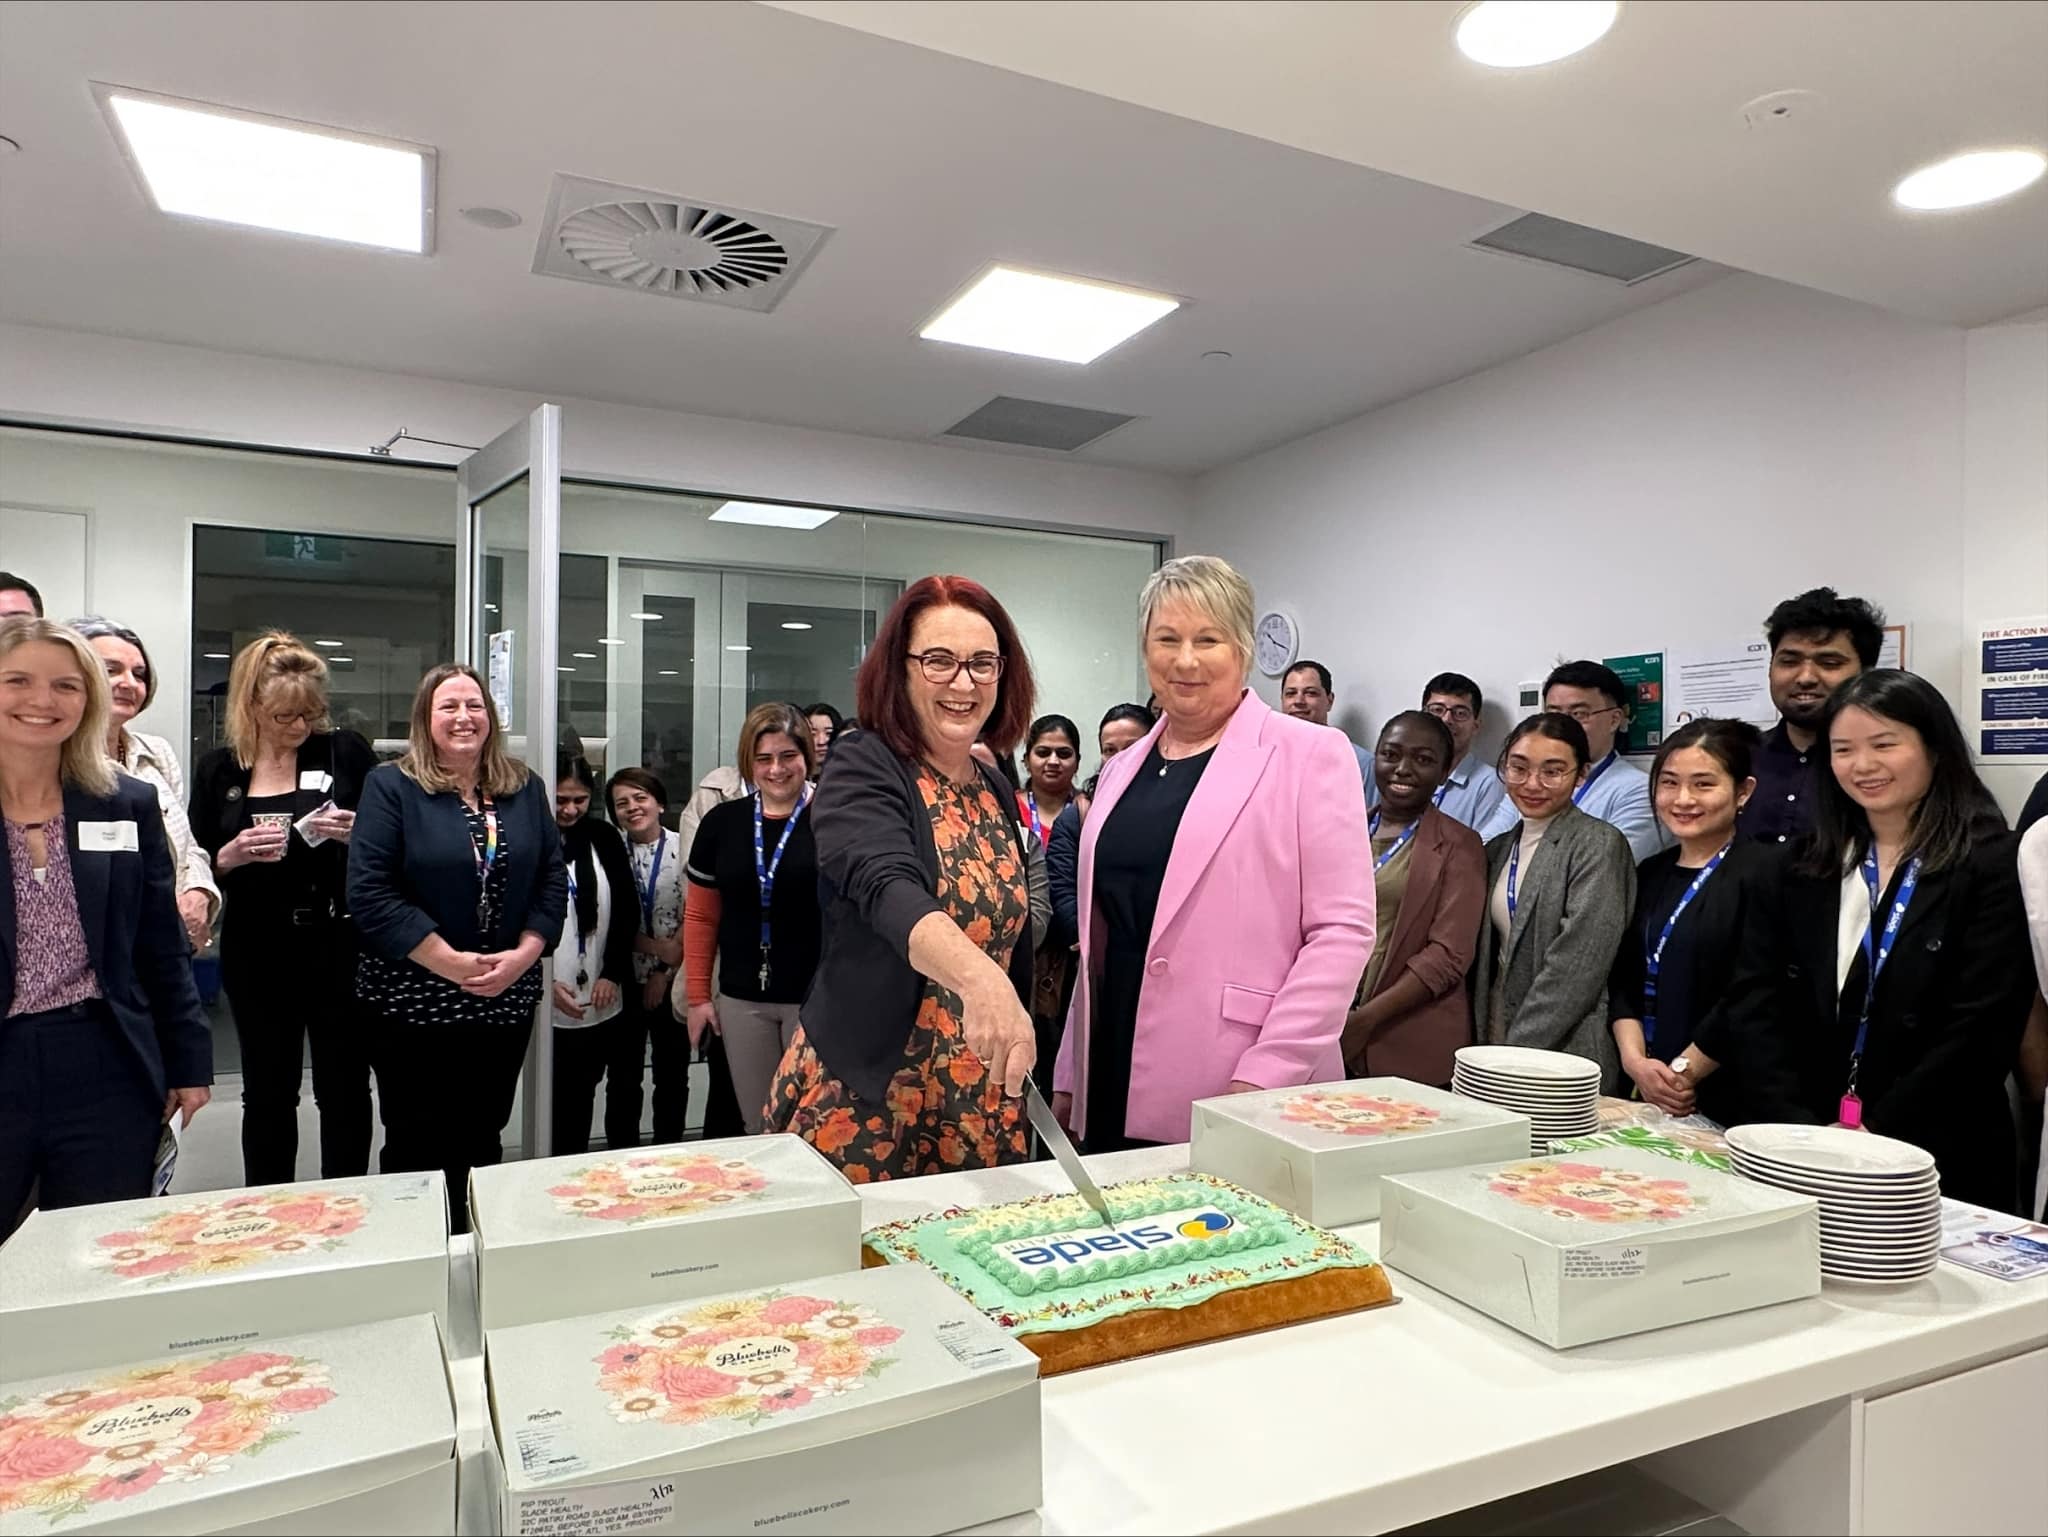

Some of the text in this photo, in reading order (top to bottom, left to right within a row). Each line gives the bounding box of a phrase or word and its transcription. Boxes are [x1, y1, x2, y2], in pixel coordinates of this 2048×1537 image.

[1983, 631, 2000, 639] FIRE
[2003, 628, 2037, 637] ACTION
[1012, 1225, 1174, 1265] slade
[169, 1331, 260, 1350] bluebellscakery.com
[715, 1344, 791, 1366] Bluebells
[87, 1406, 192, 1436] Bluebells
[521, 1504, 583, 1518] SLADE HEALTH
[566, 1511, 590, 1521] ROAD
[592, 1507, 619, 1518] SLADE
[621, 1502, 653, 1512] HEALTH
[753, 1499, 850, 1527] bluebellscakery.com
